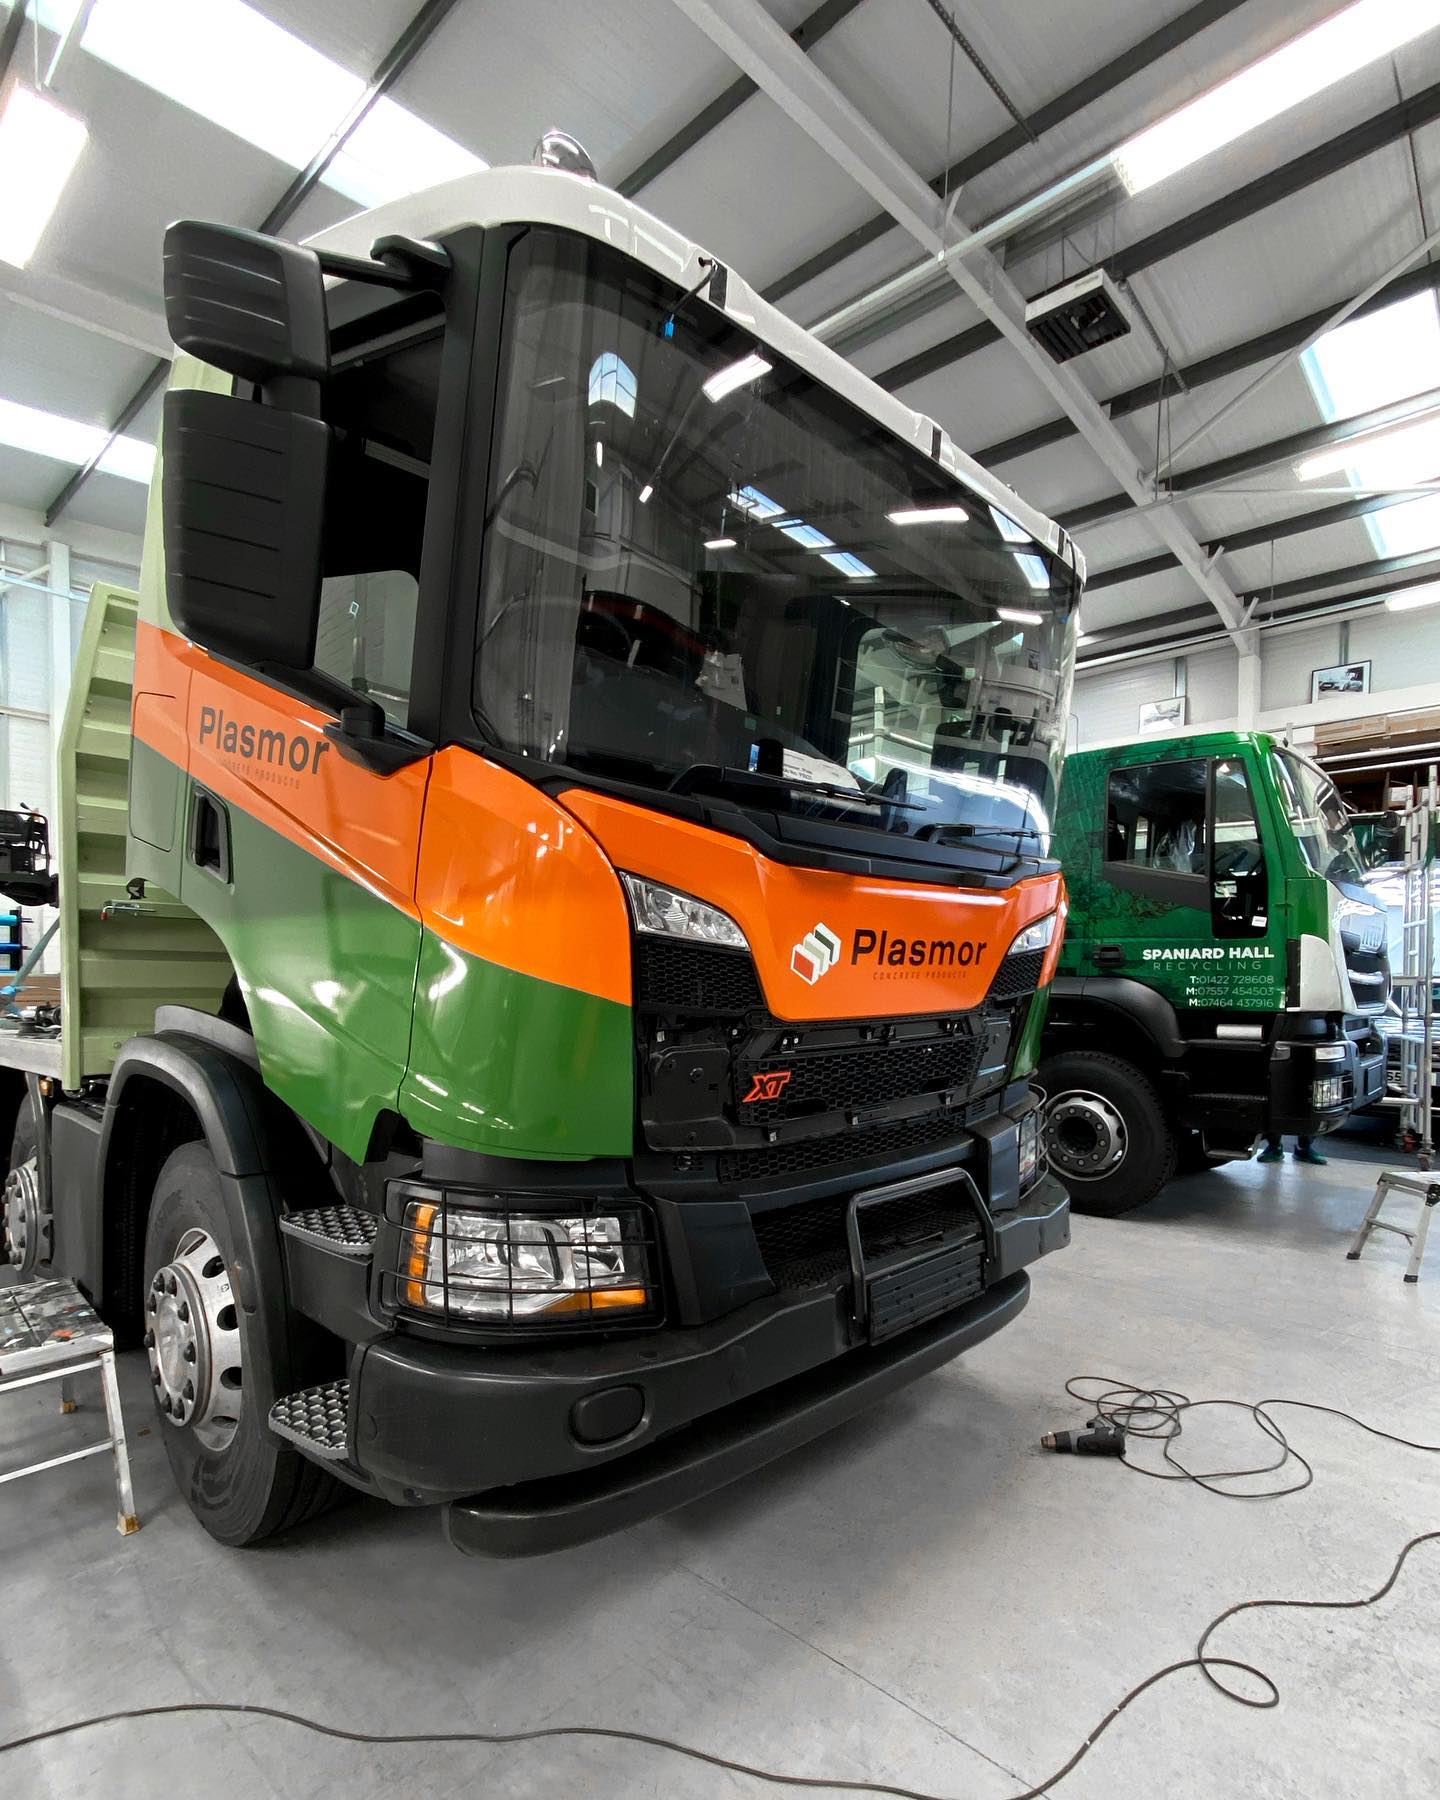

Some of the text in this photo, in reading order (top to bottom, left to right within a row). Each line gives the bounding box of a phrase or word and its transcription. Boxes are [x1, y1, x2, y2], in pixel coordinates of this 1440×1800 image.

[199, 706, 330, 775] Plasmor
[850, 928, 987, 967] Plasmor
[1142, 946, 1275, 960] SPANIARD HALL
[1153, 960, 1261, 971] RECYCLING
[1189, 975, 1274, 985] T:01422 728608
[1186, 986, 1274, 996] M:07557 454503
[1188, 998, 1274, 1007] M:07464 437916
[742, 1071, 791, 1103] XT
